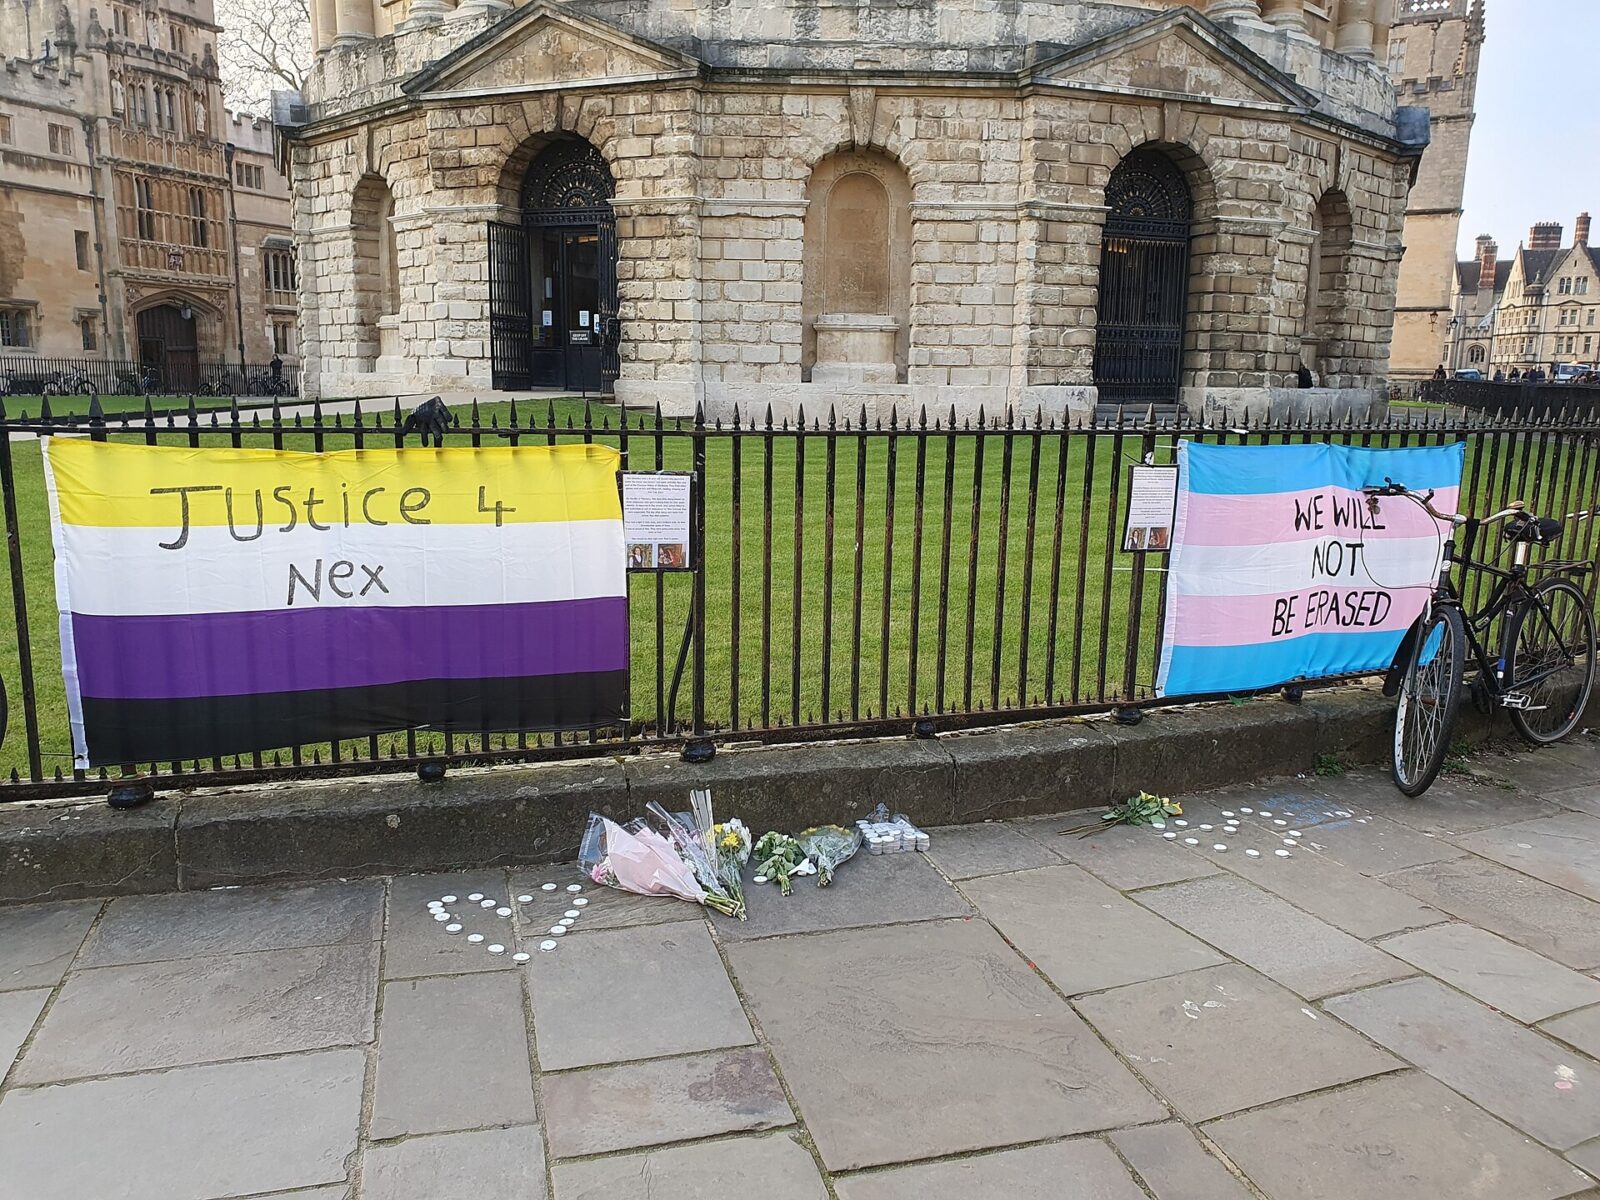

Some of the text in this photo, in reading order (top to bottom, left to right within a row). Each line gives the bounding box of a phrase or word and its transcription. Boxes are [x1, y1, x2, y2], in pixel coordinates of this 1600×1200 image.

[478, 485, 516, 527] 4
[1295, 495, 1386, 531] WE WILL
[1312, 541, 1364, 579] NOT
[287, 559, 390, 605] Nex
[1272, 591, 1392, 636] BE ERASED
